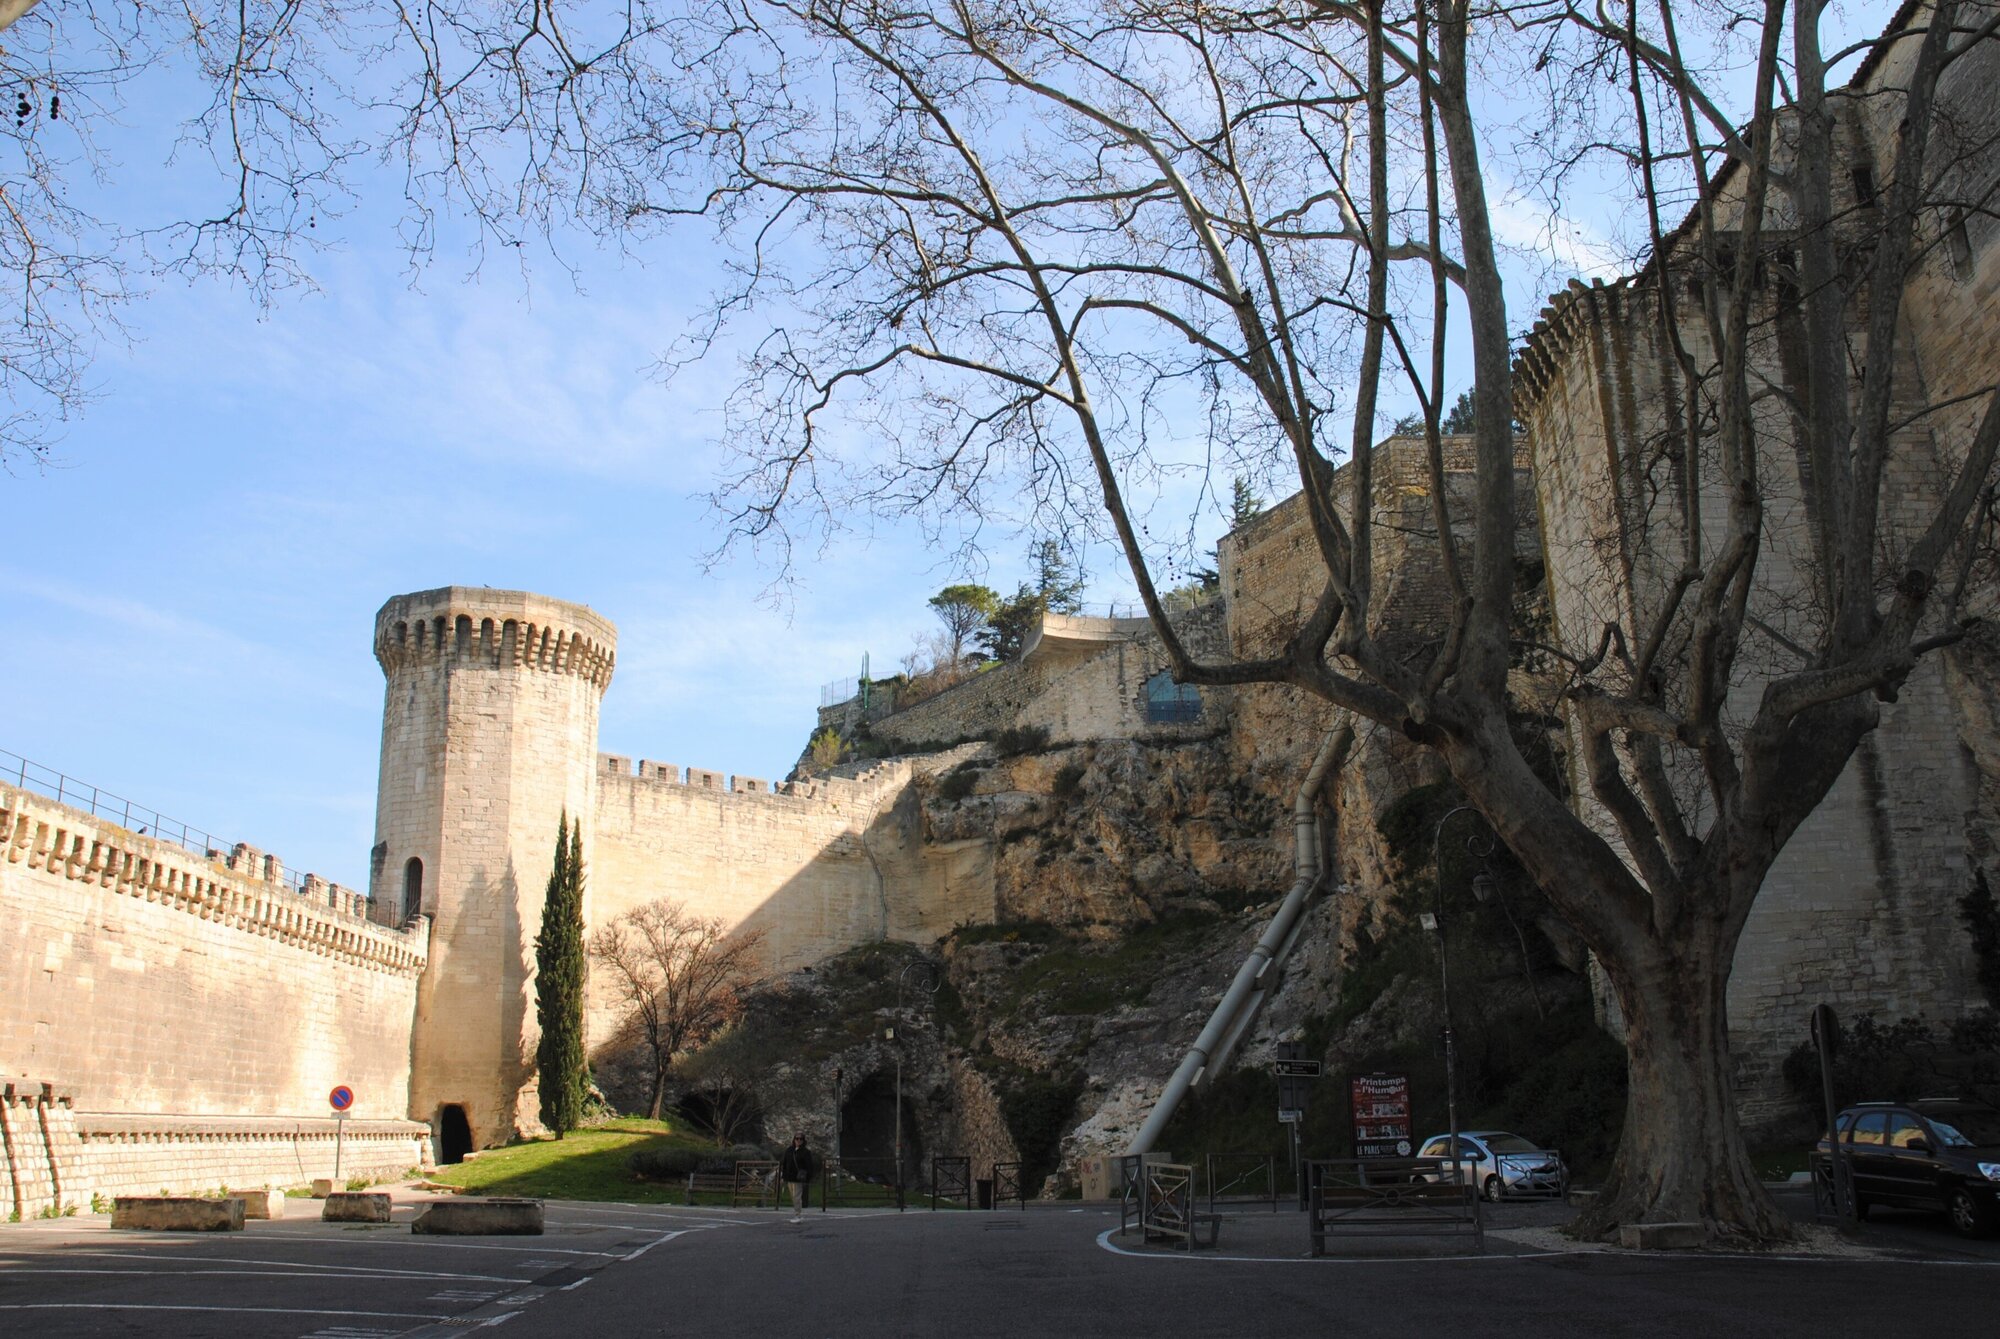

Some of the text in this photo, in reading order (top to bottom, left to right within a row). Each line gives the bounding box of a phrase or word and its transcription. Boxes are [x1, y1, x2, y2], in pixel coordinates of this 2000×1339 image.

[1360, 1077, 1406, 1086] Printemps
[1357, 1145, 1363, 1155] LE
[1364, 1145, 1380, 1155] PARIS
